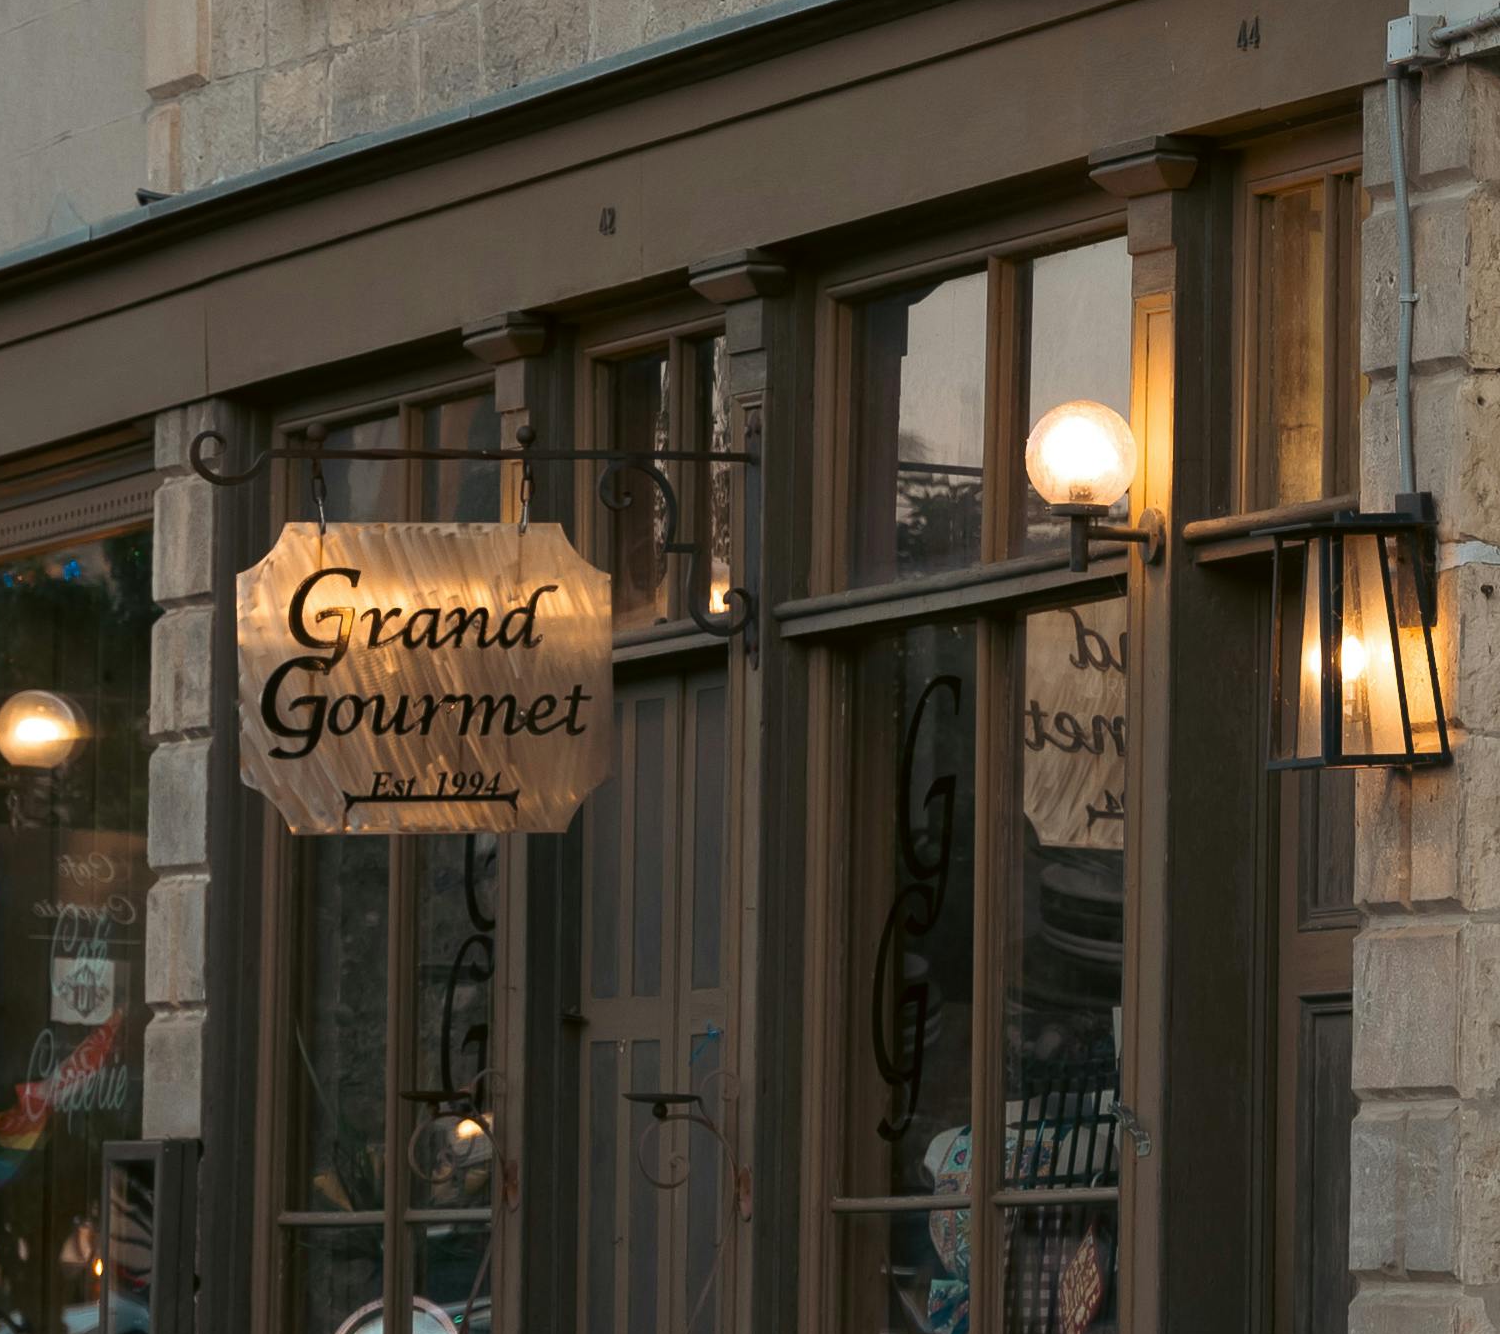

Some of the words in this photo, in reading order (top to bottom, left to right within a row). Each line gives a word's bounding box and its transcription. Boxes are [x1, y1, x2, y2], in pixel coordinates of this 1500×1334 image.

[288, 567, 559, 673] Grand
[260, 657, 592, 760] Gourmet
[369, 771, 415, 799] Est
[436, 770, 502, 799] 1994
